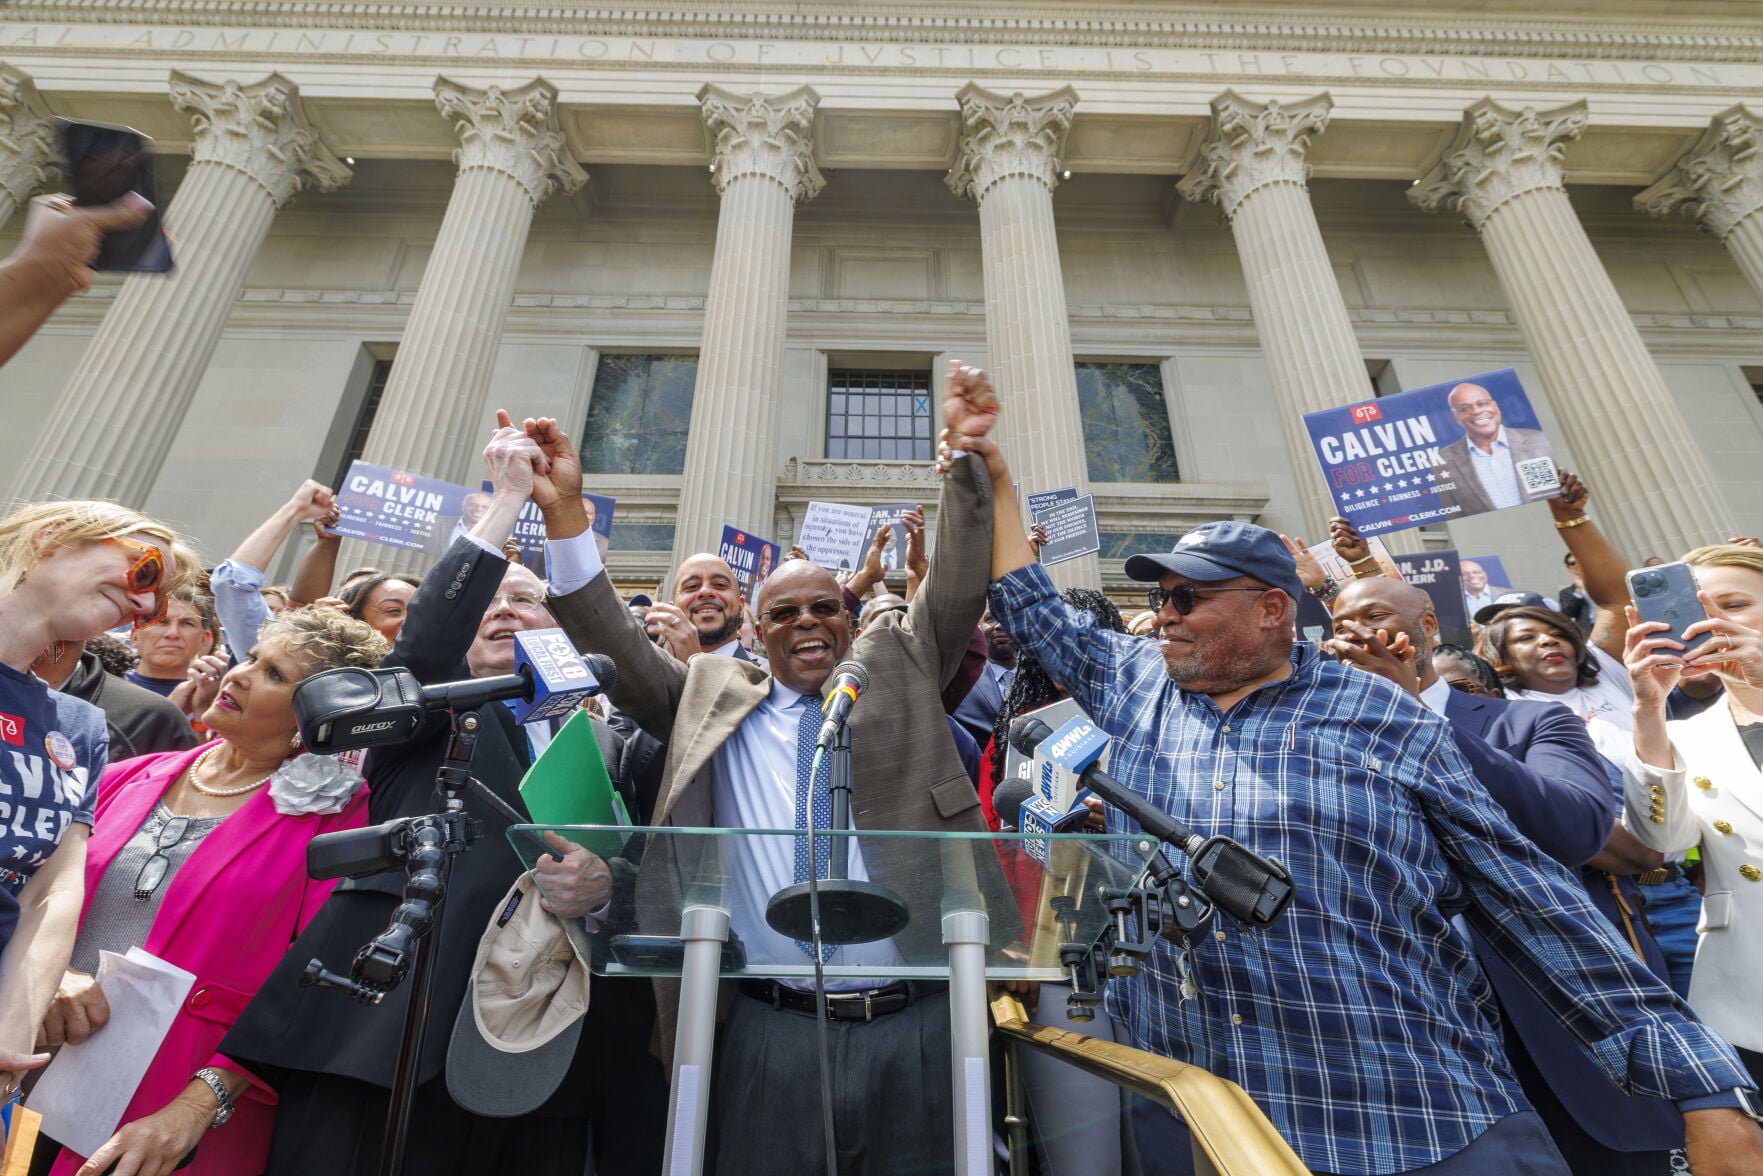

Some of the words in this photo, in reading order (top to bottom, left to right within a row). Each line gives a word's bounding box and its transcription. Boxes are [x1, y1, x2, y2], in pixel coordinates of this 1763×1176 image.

[130, 29, 656, 60] ADMINISTRATION
[706, 43, 775, 62] OF
[1105, 50, 1153, 70] IS
[1200, 53, 1304, 74] THE
[1320, 415, 1436, 465] CALVIN
[1330, 462, 1376, 490] FOR
[1376, 446, 1447, 478] CLERK
[350, 475, 443, 511] CALVIN
[1343, 498, 1380, 513] DILIGENCE
[1388, 489, 1421, 503] FAIRNESS
[1430, 482, 1457, 496] JUSTICE
[383, 501, 438, 524] CLERK
[820, 517, 851, 527] situations
[1062, 506, 1089, 519] REMEMBER
[1358, 504, 1462, 534] CALVINFORCLERK.COM
[410, 529, 432, 538] JUSTICE
[514, 521, 547, 537] LERK
[802, 533, 825, 543] chosen
[839, 538, 851, 546] side
[721, 542, 754, 570] CALVIN
[806, 544, 816, 552] the
[1421, 559, 1449, 573] J.D.
